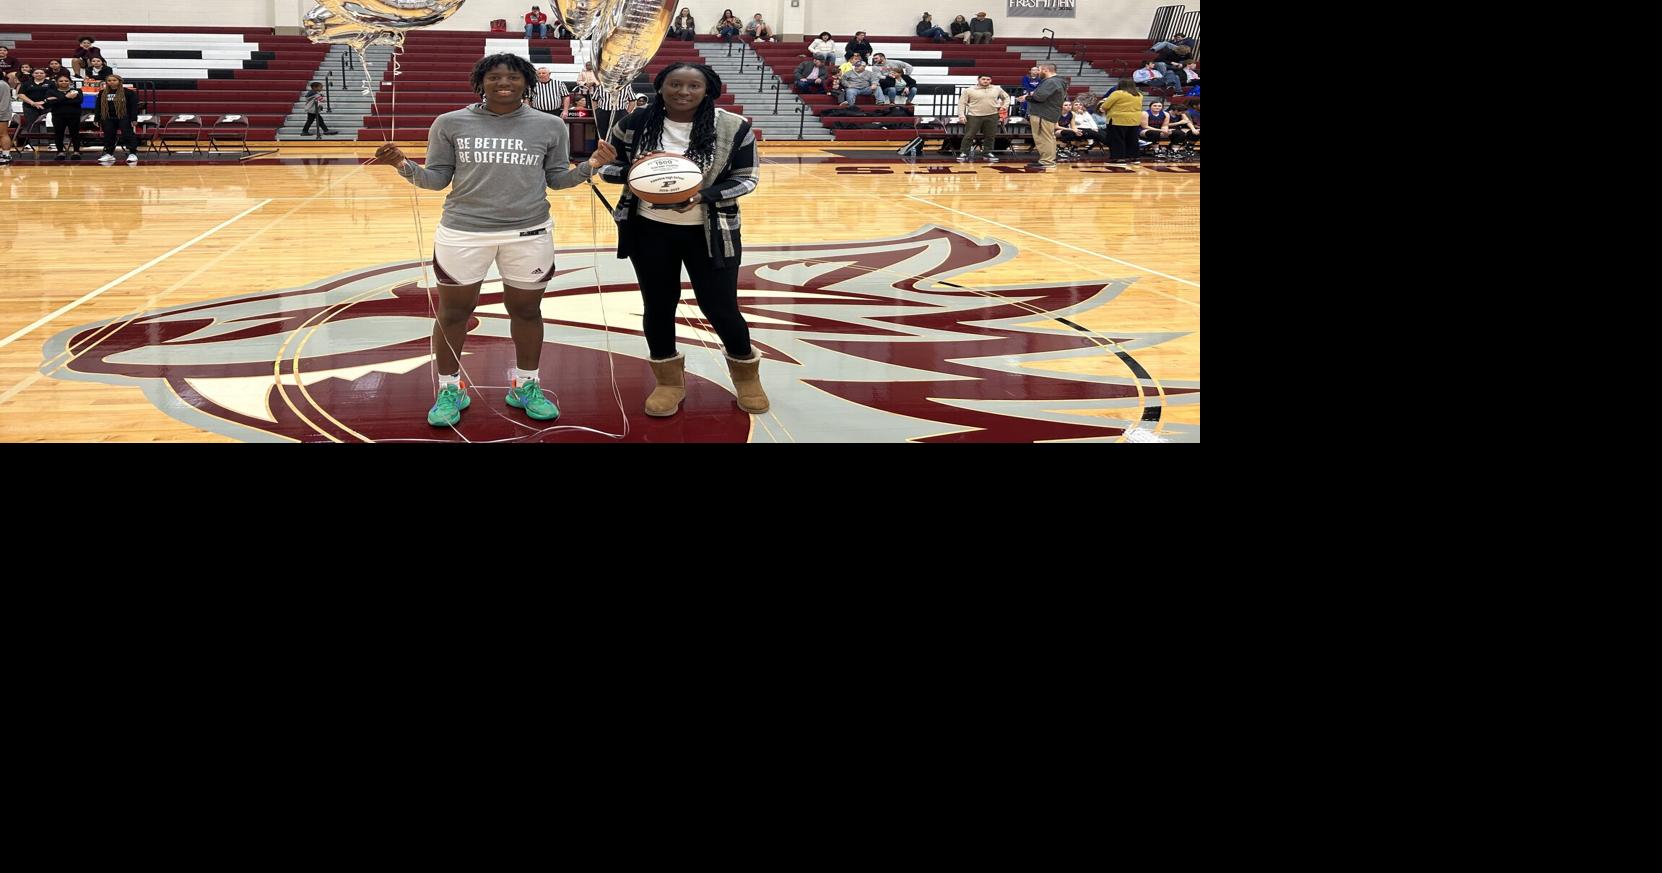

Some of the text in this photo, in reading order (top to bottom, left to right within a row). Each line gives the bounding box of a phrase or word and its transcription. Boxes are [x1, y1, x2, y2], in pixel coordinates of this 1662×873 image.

[456, 137, 528, 151] BE BETTER.
[458, 151, 471, 163] BE
